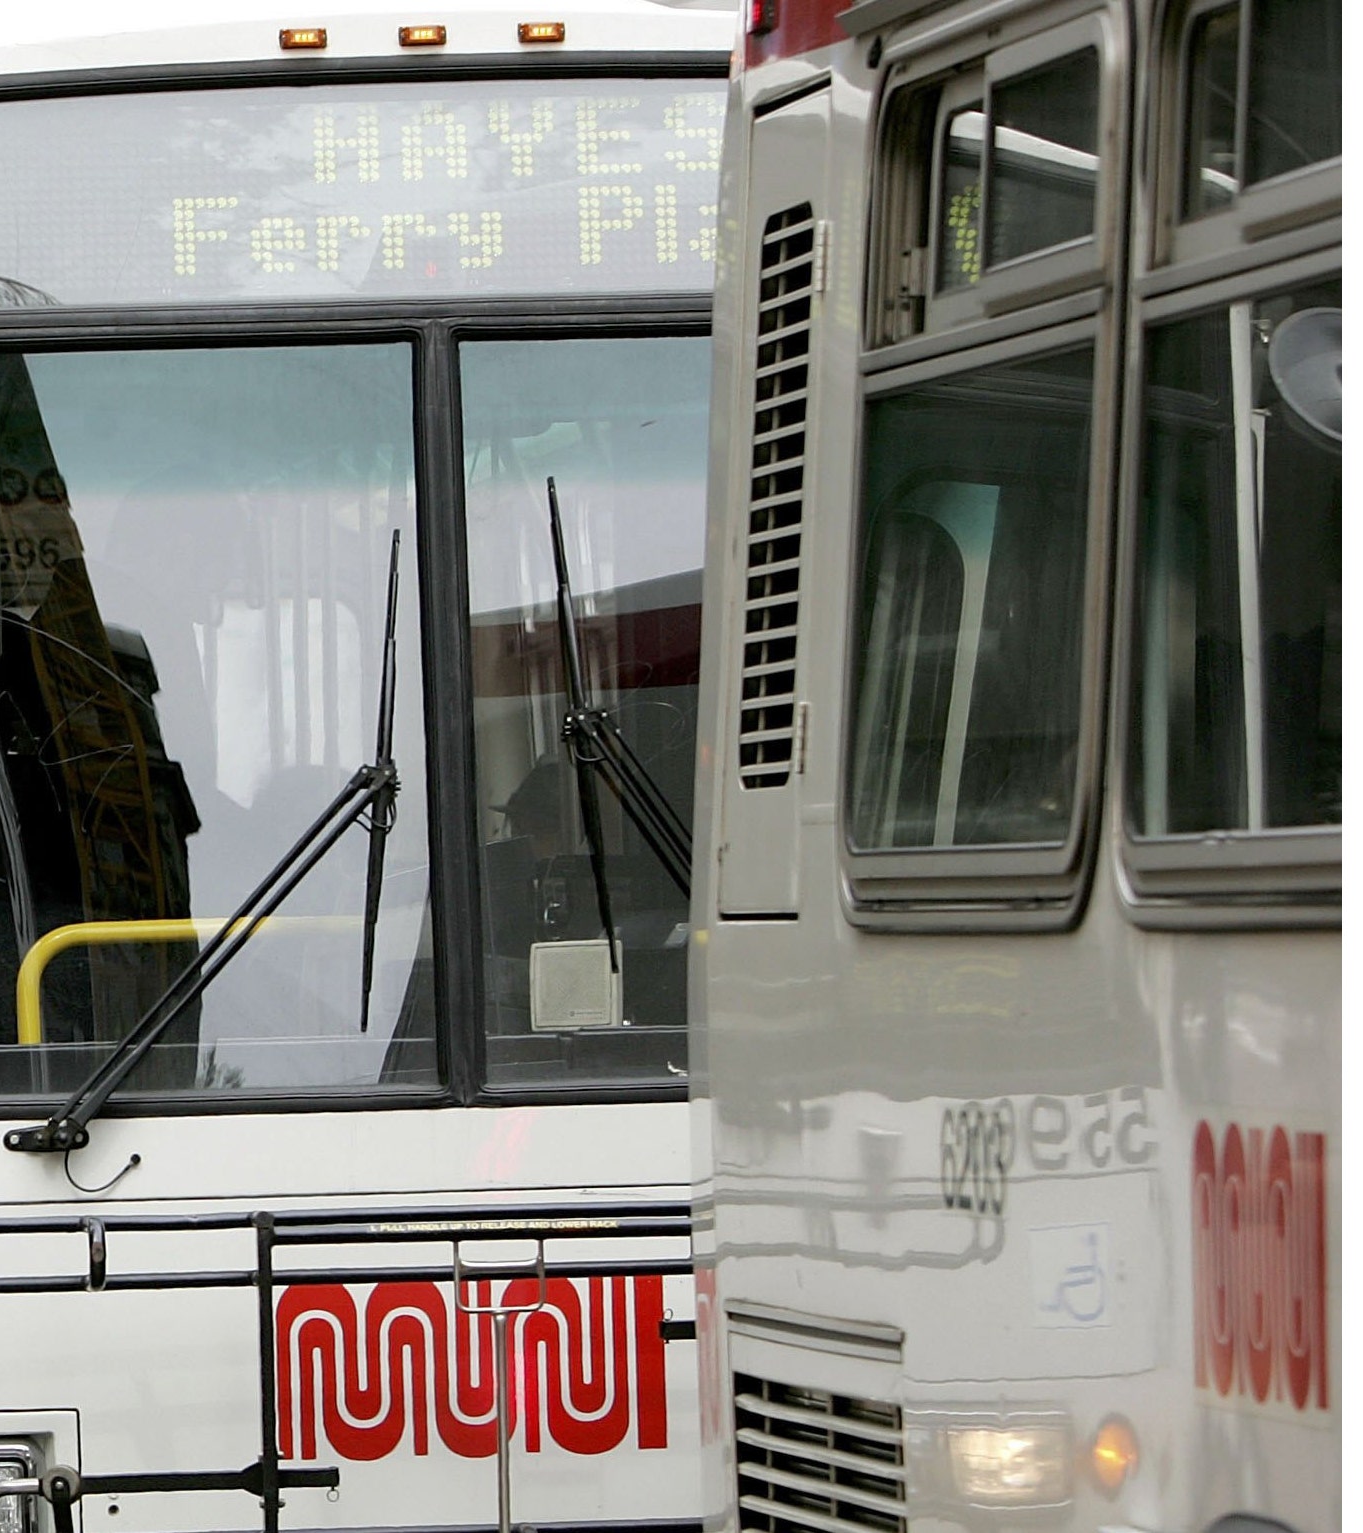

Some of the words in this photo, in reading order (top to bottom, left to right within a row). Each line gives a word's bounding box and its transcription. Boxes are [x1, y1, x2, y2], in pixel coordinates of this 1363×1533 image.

[313, 94, 725, 183] HAYES
[173, 196, 503, 276] Ferry
[380, 1223, 406, 1233] PULL
[407, 1222, 449, 1232] HANDLE
[449, 1222, 464, 1231] UP
[466, 1222, 479, 1230] TO
[480, 1221, 526, 1230] RELEASE
[528, 1220, 551, 1229] AND
[551, 1220, 588, 1229] LOWER
[589, 1219, 619, 1228] RACK
